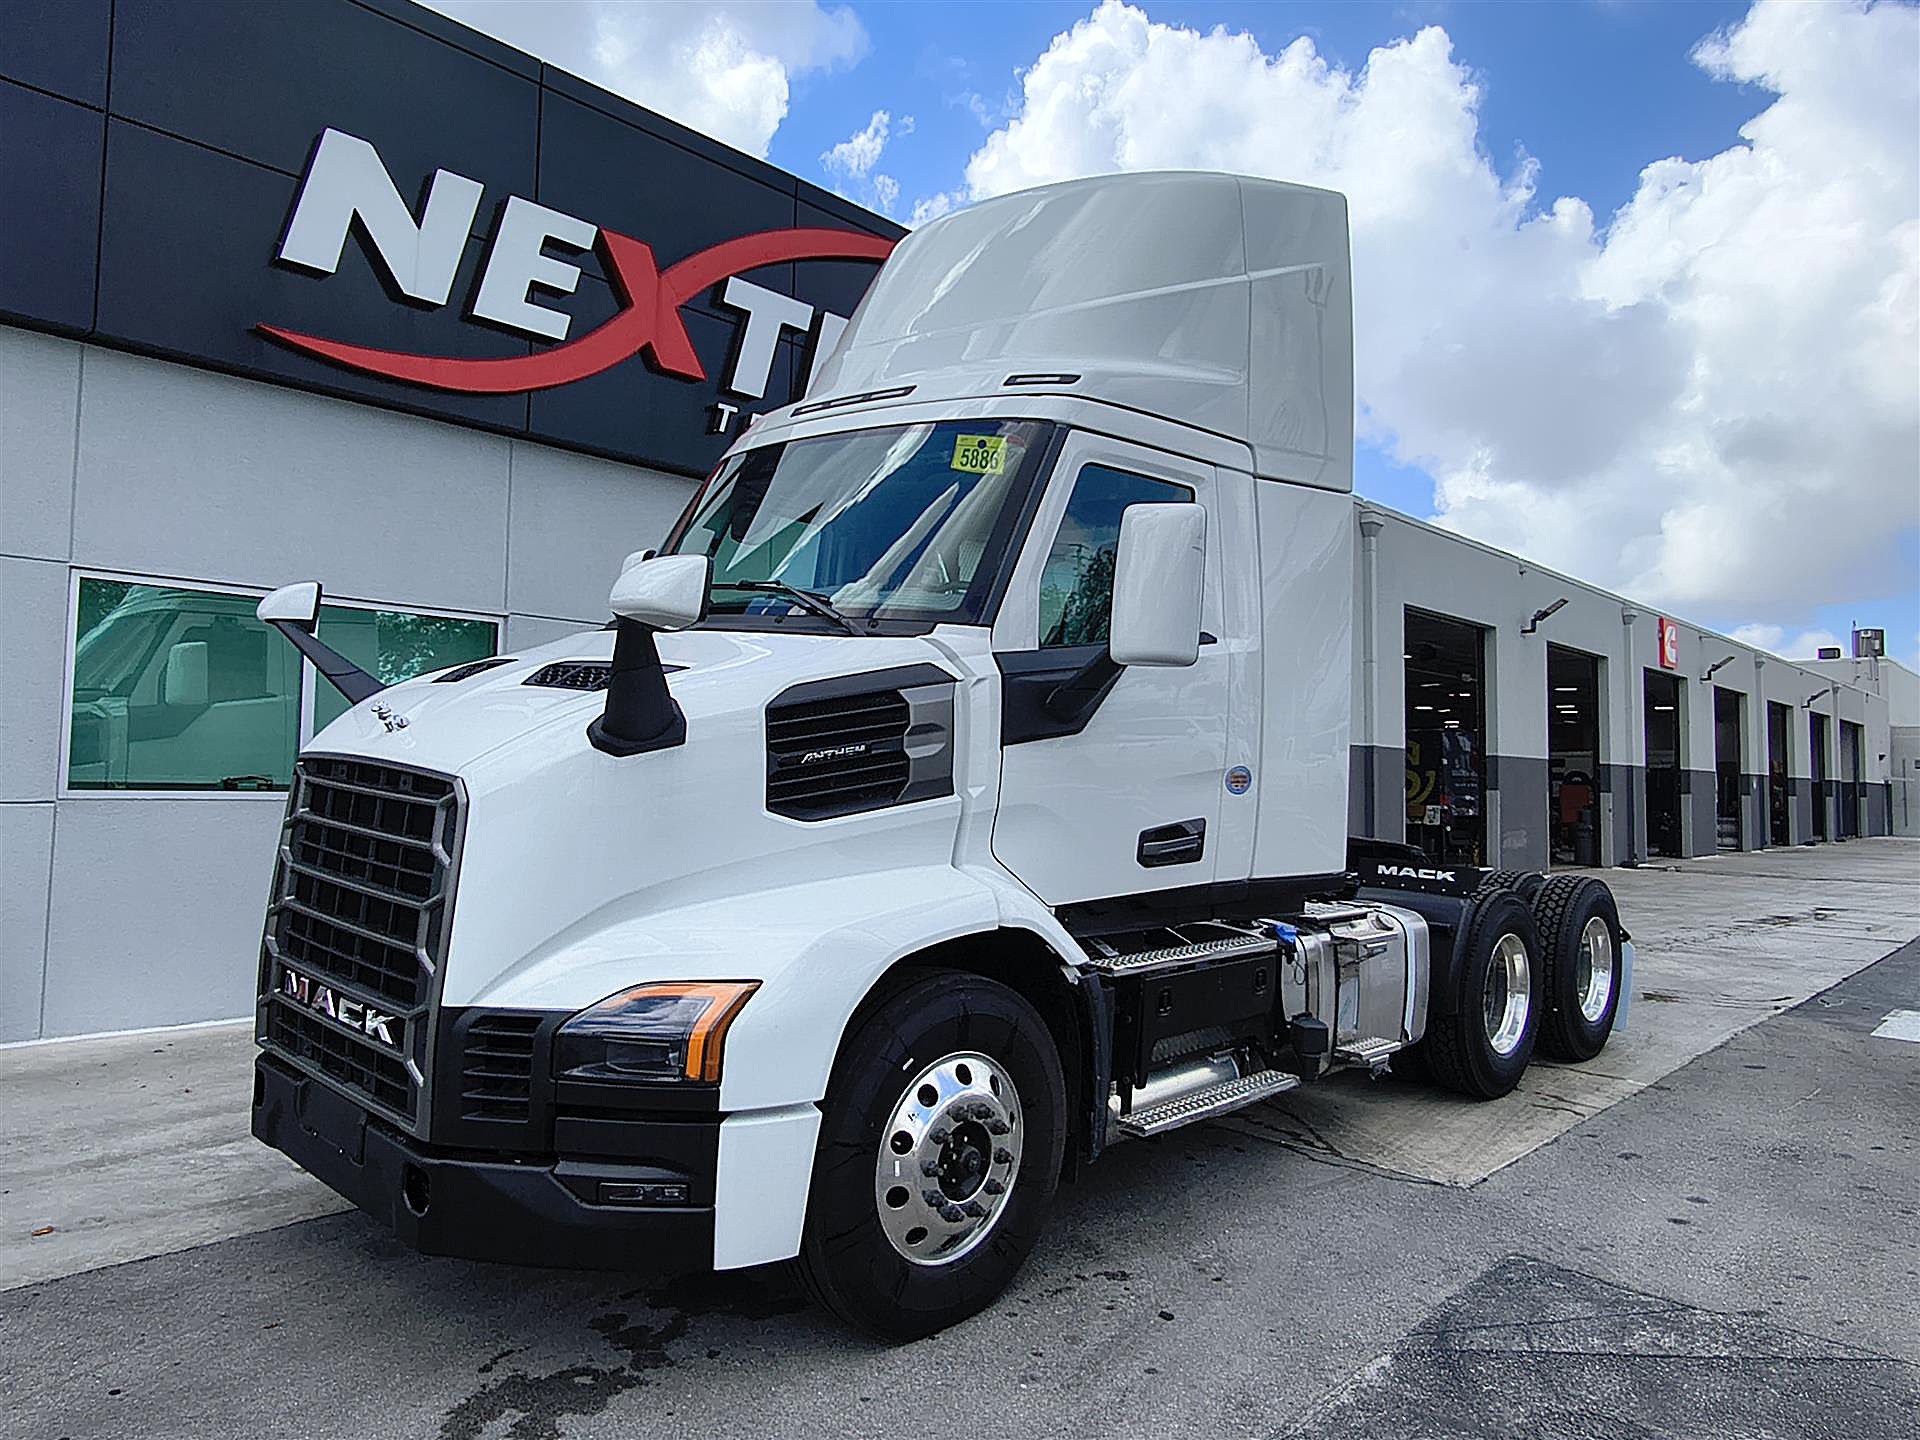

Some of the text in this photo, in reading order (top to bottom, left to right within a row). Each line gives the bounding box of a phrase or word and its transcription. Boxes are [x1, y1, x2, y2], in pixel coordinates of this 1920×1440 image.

[960, 448, 999, 469] 5886
[801, 744, 866, 764] ANTHEM
[1377, 864, 1456, 882] MACK
[284, 969, 396, 1045] MACK
